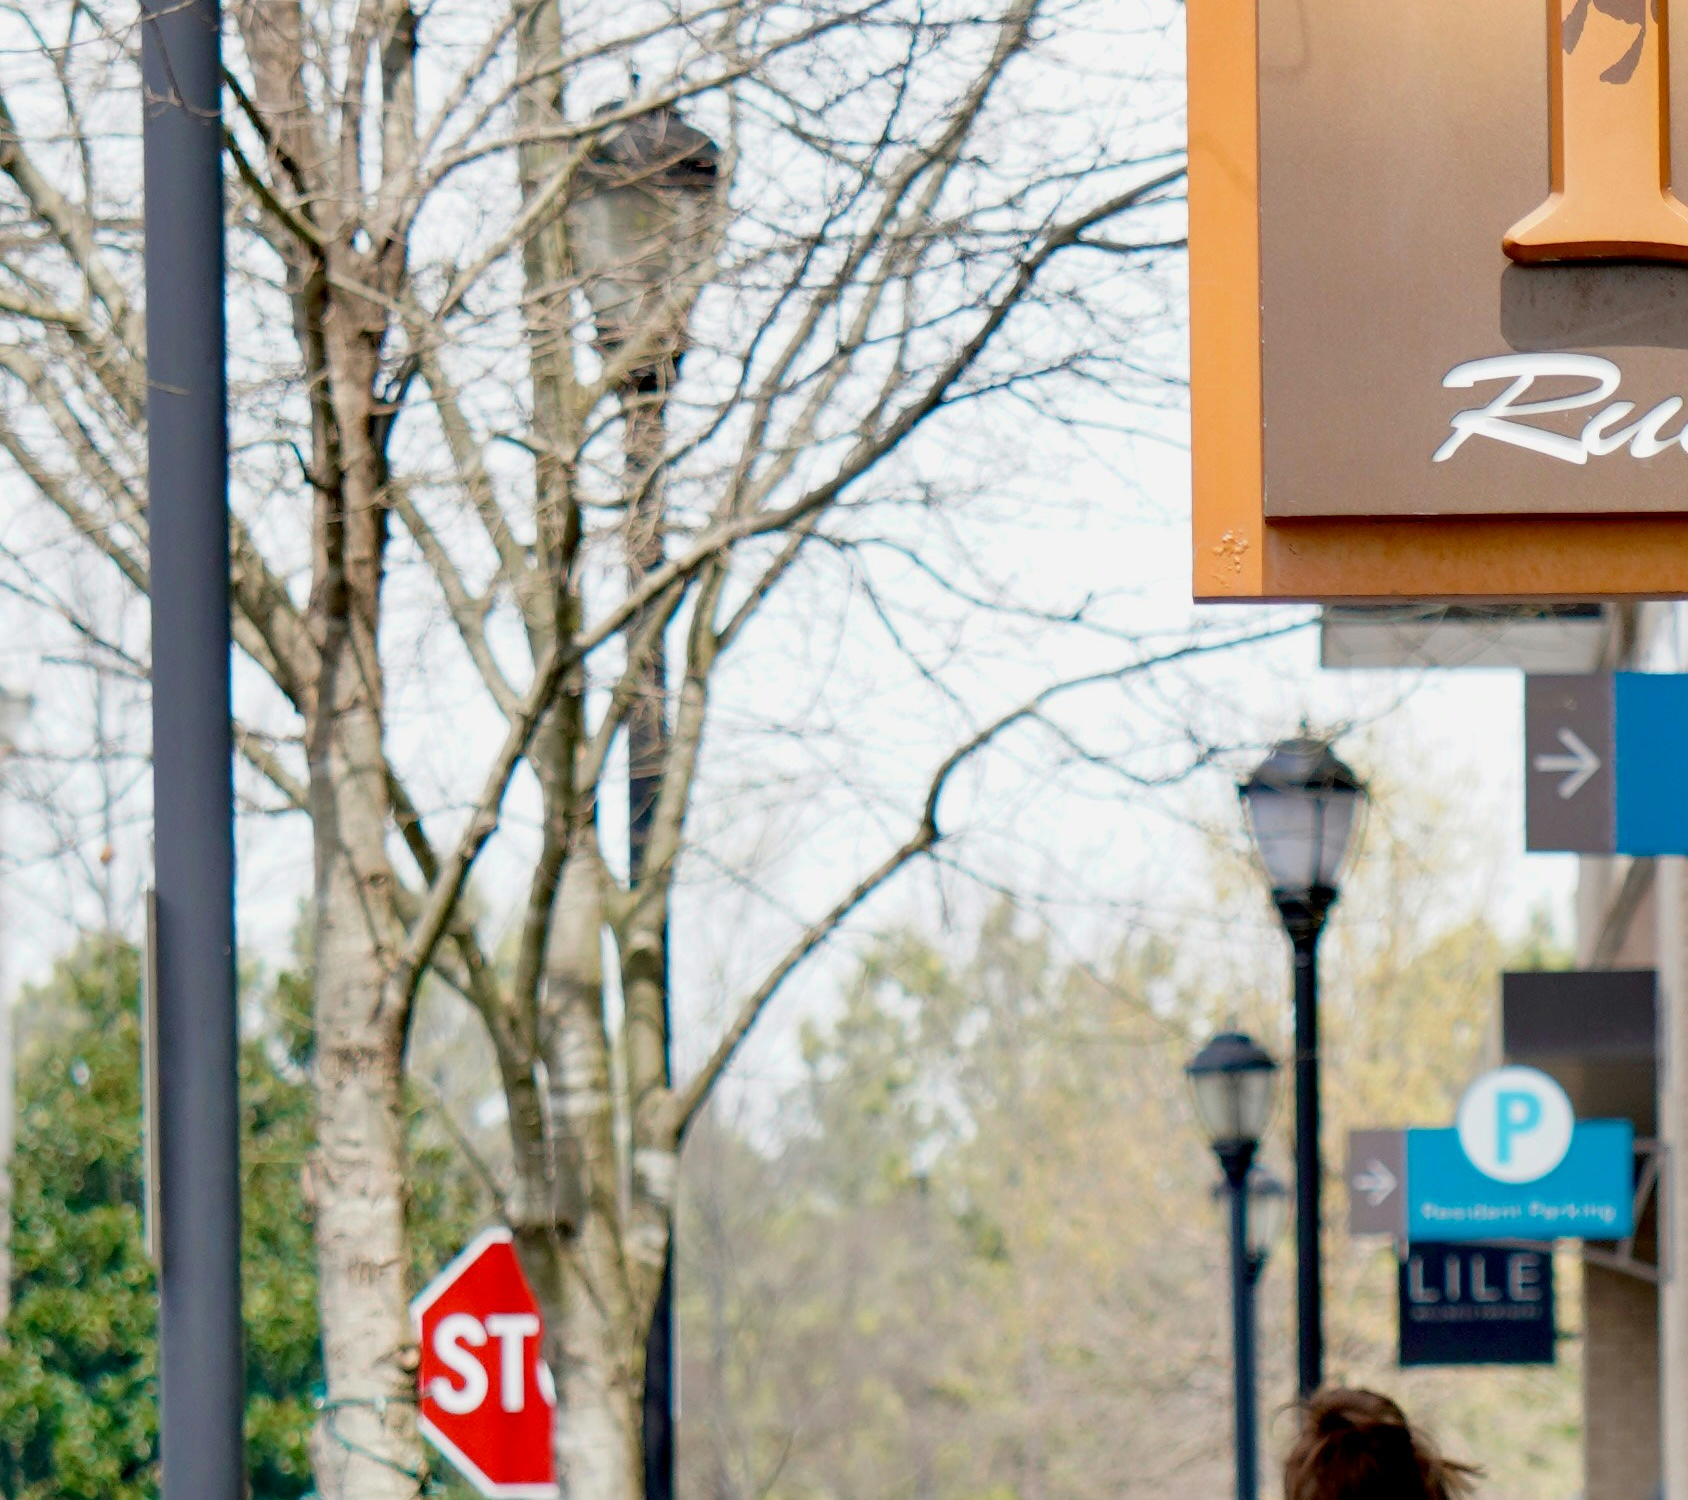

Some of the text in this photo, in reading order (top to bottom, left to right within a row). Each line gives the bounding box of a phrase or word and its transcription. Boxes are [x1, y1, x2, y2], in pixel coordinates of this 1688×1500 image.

[1496, 1090, 1543, 1164] P
[1528, 1200, 1617, 1225] Parking
[1408, 1252, 1543, 1303] LILE
[429, 1312, 557, 1415] ST
